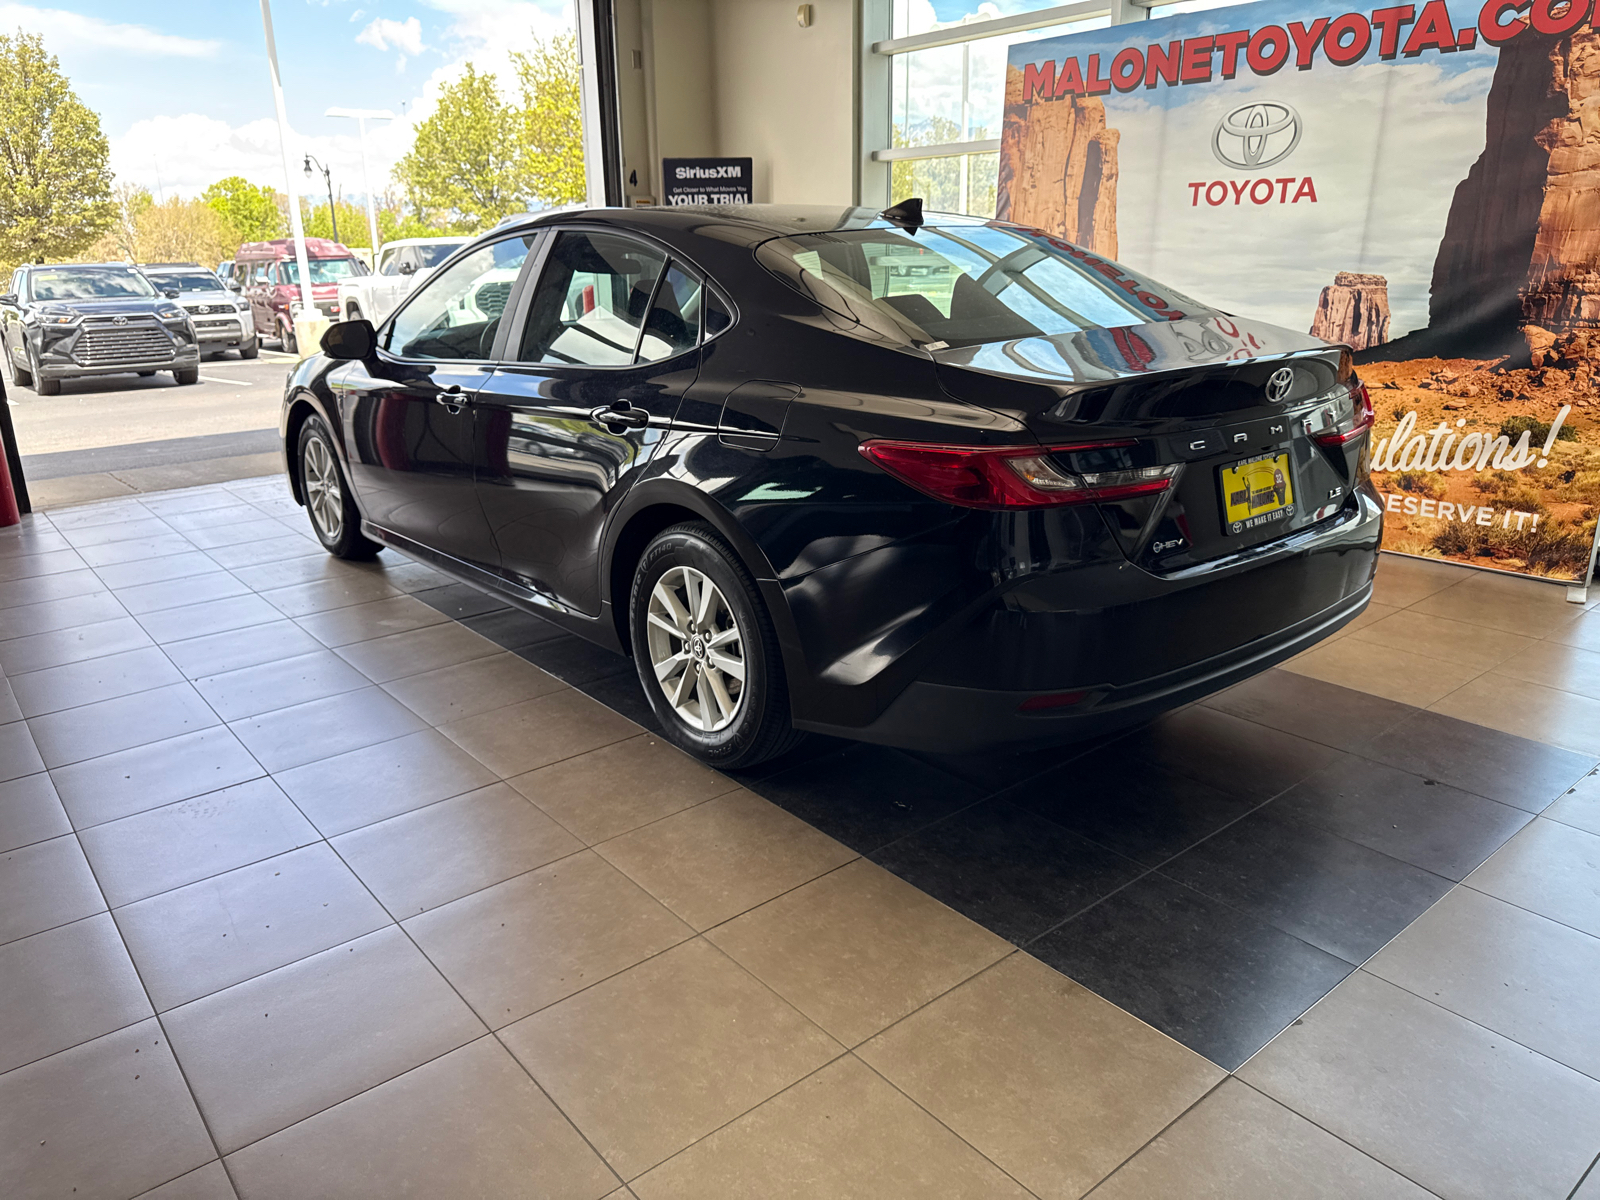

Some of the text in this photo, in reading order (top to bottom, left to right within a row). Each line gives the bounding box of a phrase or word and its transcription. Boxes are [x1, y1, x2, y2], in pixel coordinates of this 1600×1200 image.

[1022, 0, 1600, 102] MALONETOYOTA.CO
[629, 169, 638, 187] 4
[675, 166, 742, 179] SiriusXM
[668, 194, 708, 206] YOUR
[1188, 177, 1318, 207] TOYOTA
[1275, 473, 1283, 484] 32
[1329, 487, 1342, 499] LE
[1245, 520, 1254, 528] WE
[1254, 516, 1267, 525] MAKE
[1272, 509, 1284, 519] EASY
[1503, 510, 1540, 533] IT!
